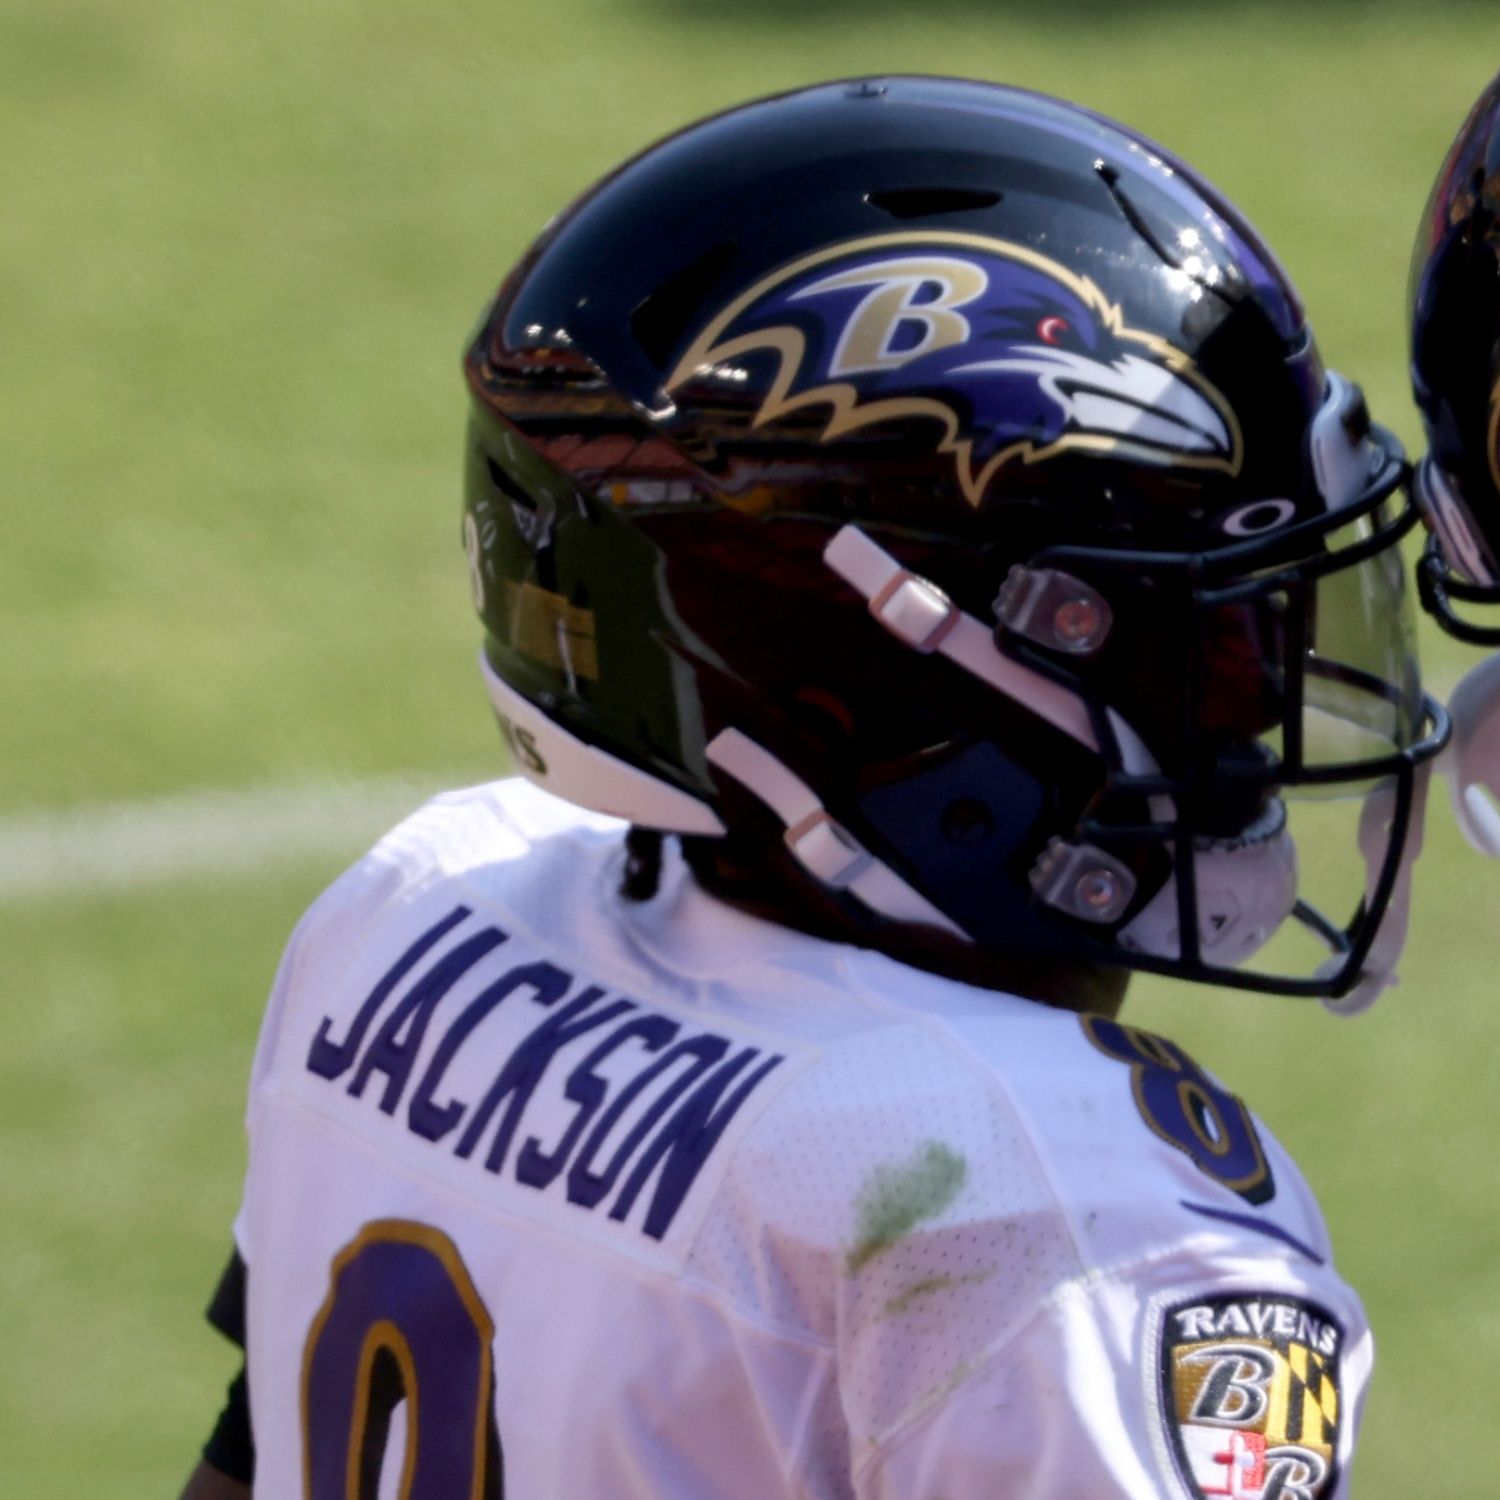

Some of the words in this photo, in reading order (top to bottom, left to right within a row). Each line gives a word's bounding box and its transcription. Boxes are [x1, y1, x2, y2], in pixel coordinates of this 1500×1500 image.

[785, 256, 990, 378] B
[305, 905, 785, 1242] JACKSON
[1175, 1303, 1339, 1356] RAVENS
[1178, 1343, 1276, 1426] B
